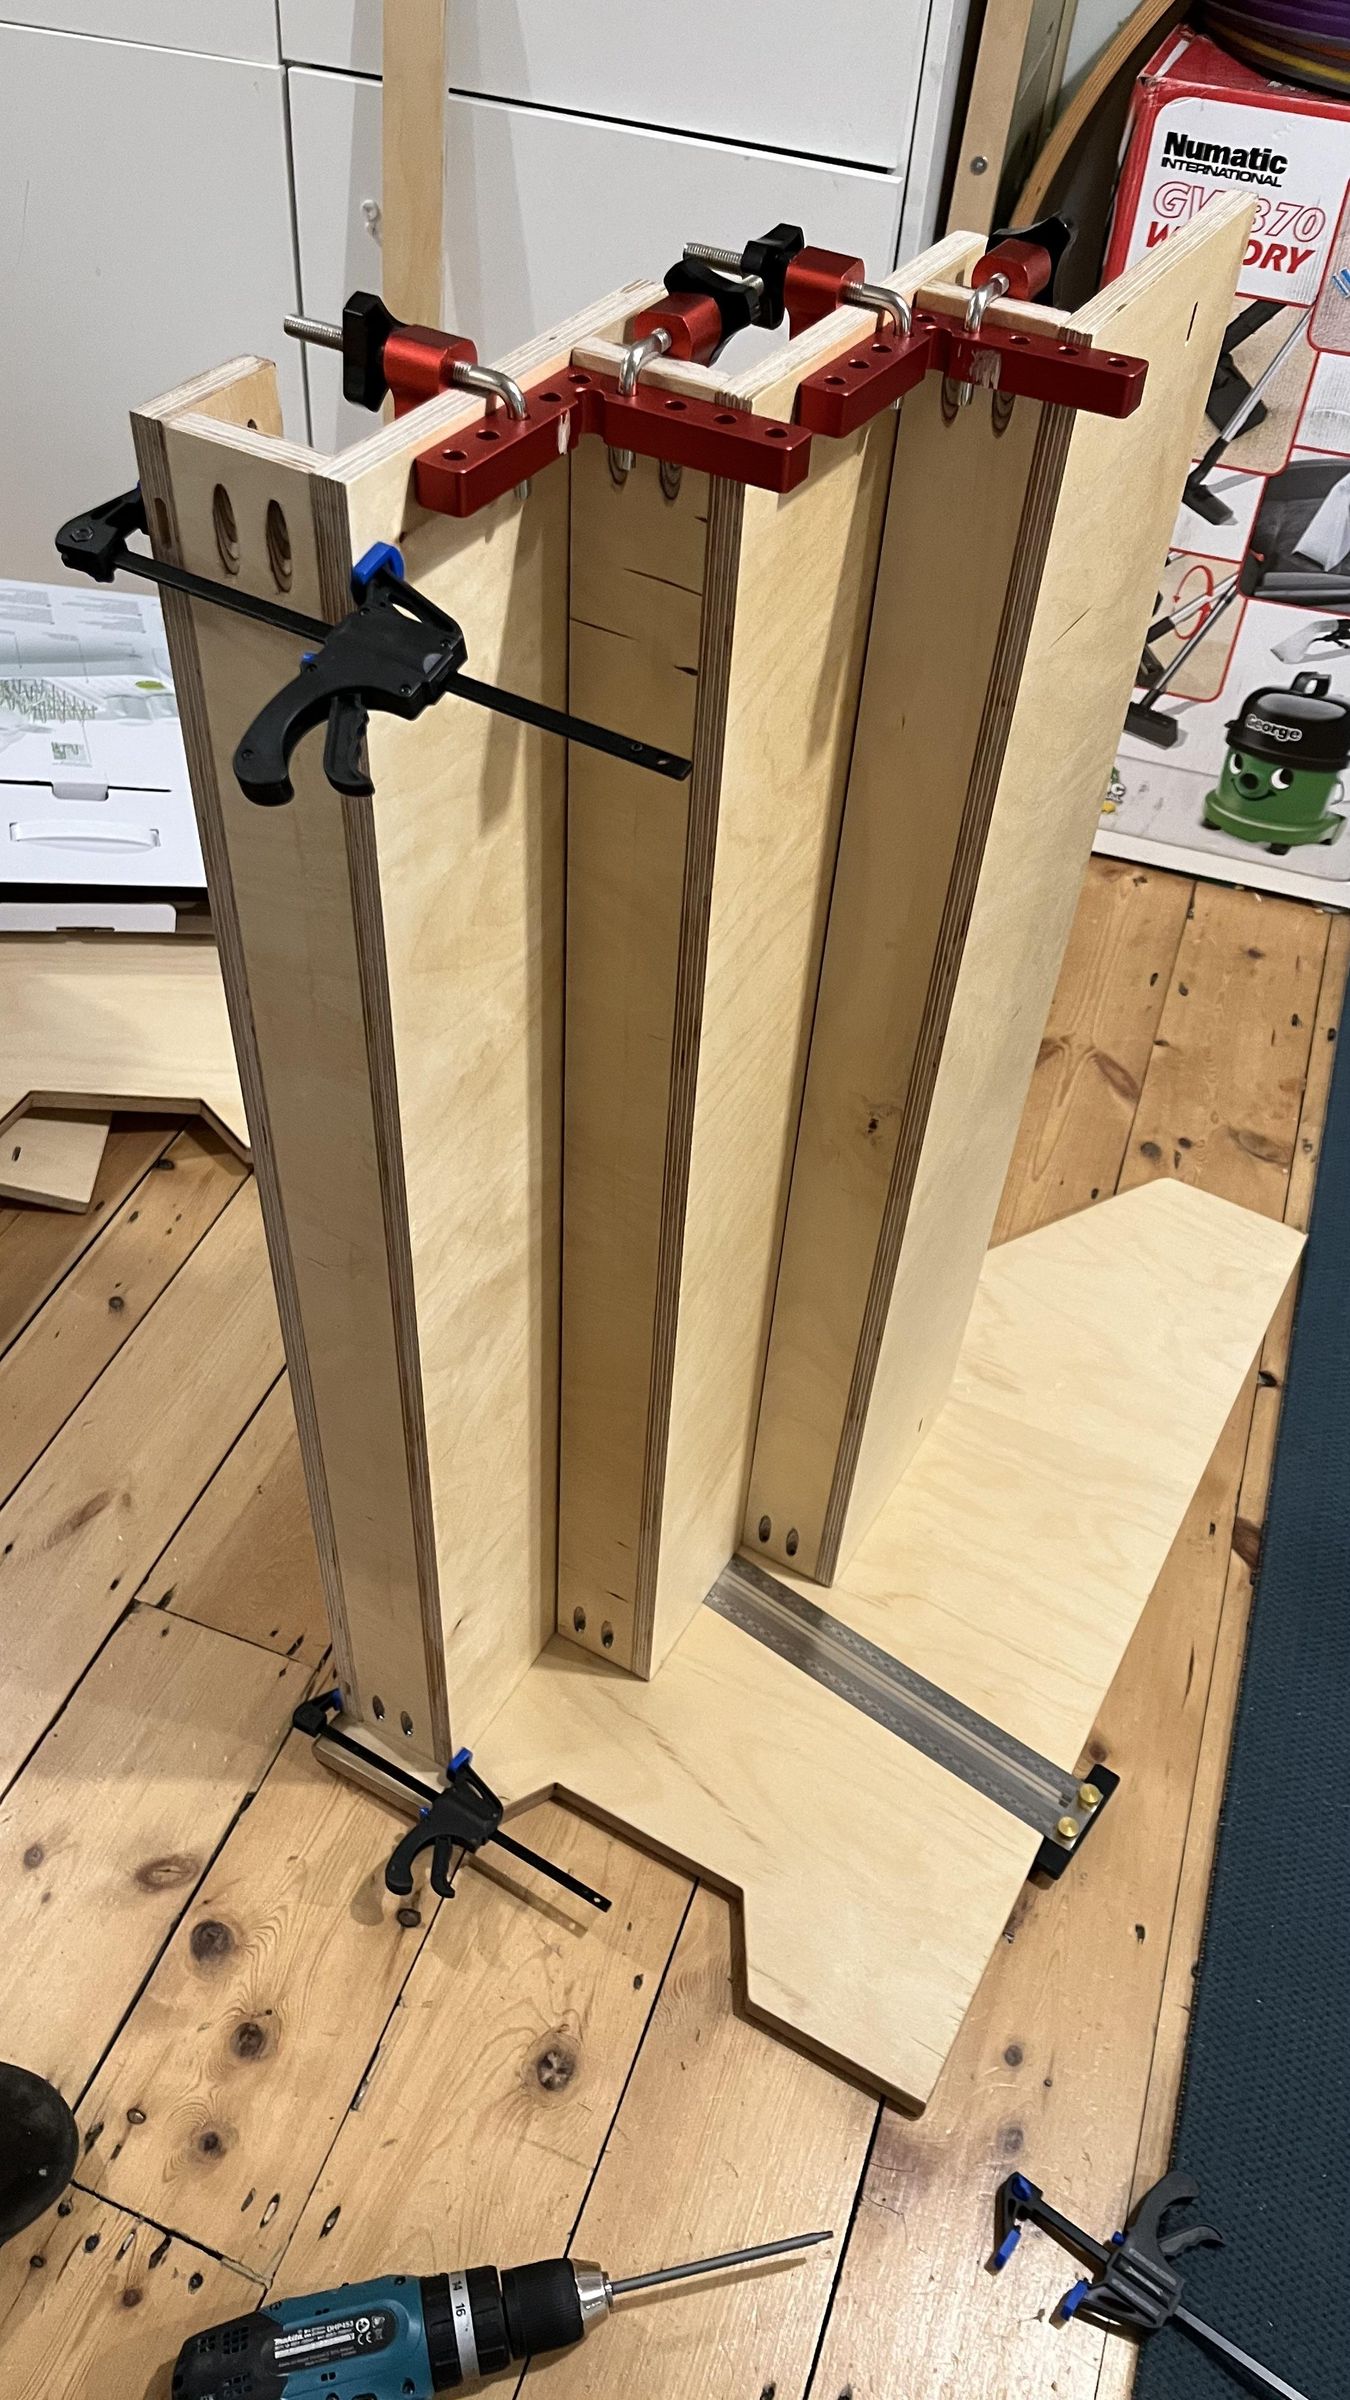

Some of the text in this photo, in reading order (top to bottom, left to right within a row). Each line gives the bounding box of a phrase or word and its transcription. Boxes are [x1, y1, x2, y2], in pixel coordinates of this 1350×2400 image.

[1164, 131, 1288, 175] Numatic
[1160, 156, 1283, 188] INTERNATIONAL
[1245, 713, 1303, 742] George
[455, 2302, 466, 2317] 16
